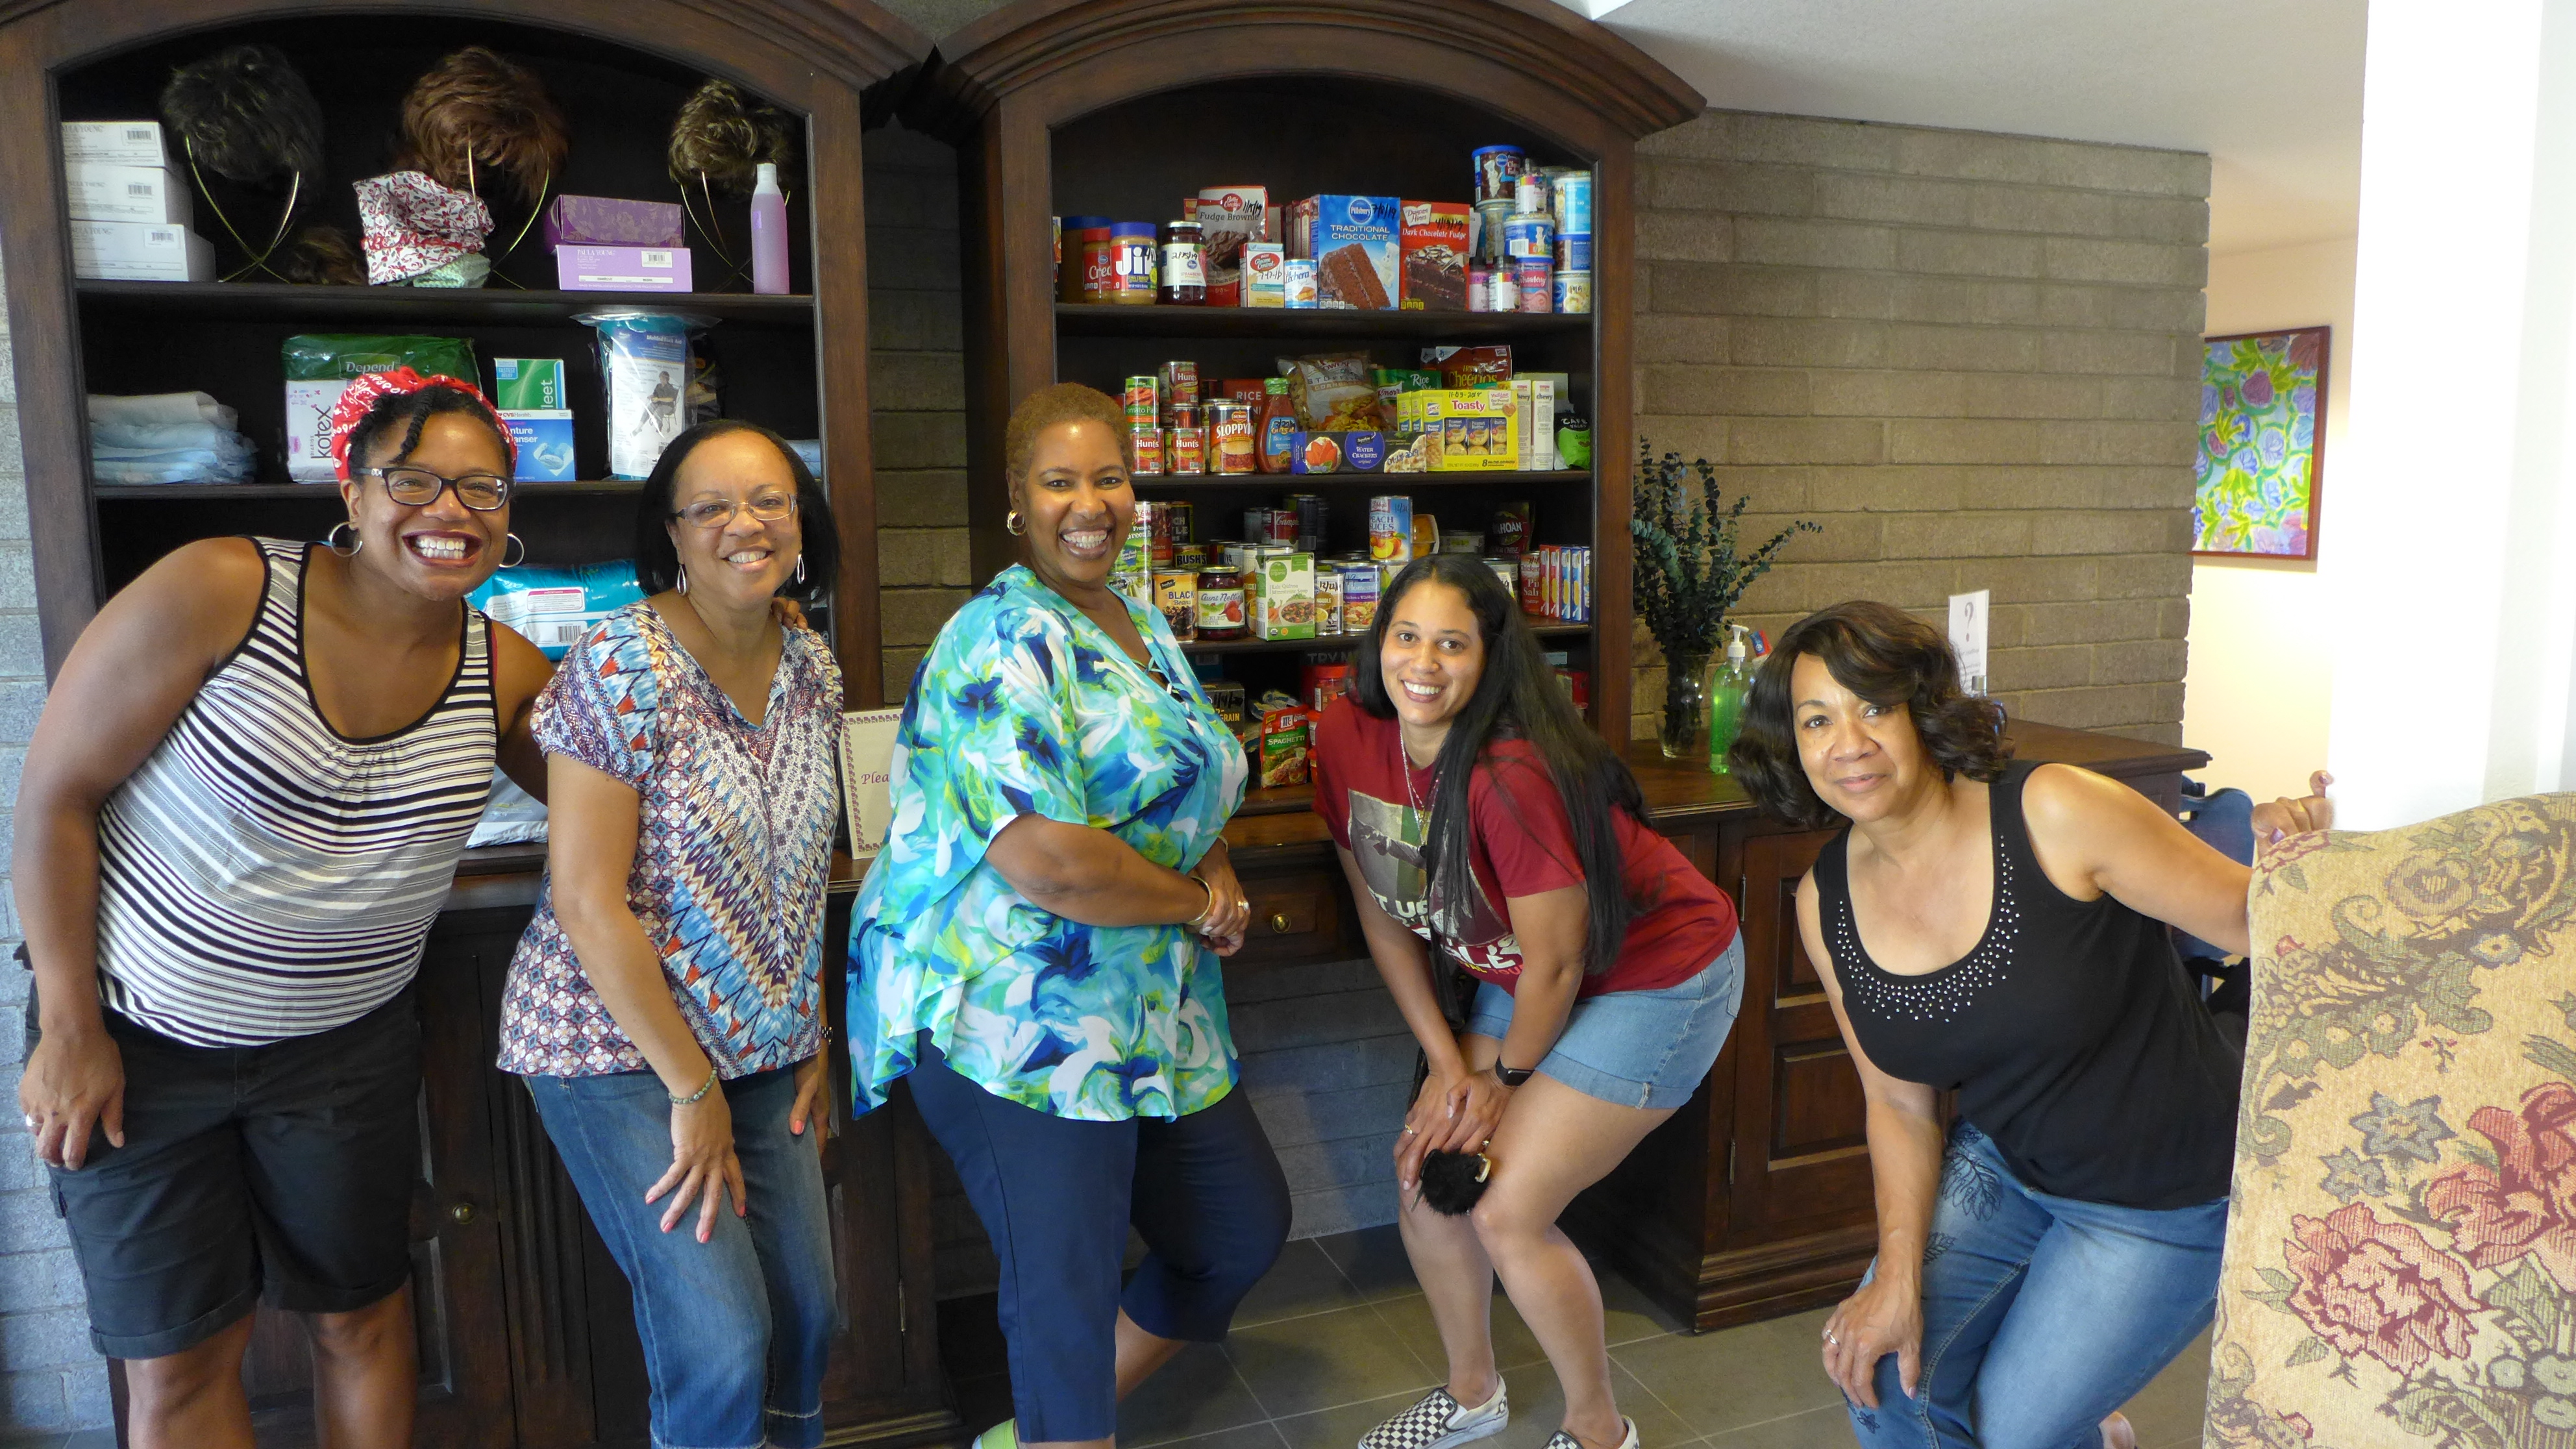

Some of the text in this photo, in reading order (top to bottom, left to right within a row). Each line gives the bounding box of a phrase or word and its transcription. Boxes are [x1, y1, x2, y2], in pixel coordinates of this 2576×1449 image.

[1200, 212, 1225, 222] Fudge
[1330, 225, 1390, 233] TRADITIONAL
[1419, 229, 1448, 238] Chocolate
[1449, 230, 1467, 240] Fudge
[1331, 232, 1388, 242] CHOCOLATE
[1089, 265, 1112, 280] Crea
[345, 361, 395, 375] Depend
[1411, 374, 1430, 386] Rice
[540, 380, 554, 410] leet
[1236, 391, 1261, 401] RICE
[1378, 388, 1401, 398] Knorr
[1452, 400, 1485, 412] Toasty
[311, 405, 333, 459] kotex
[1217, 423, 1248, 439] SLOPPY
[1176, 554, 1207, 565] BUSH'S
[1268, 735, 1305, 745] SPAGHETTI
[861, 771, 889, 784] Plea
